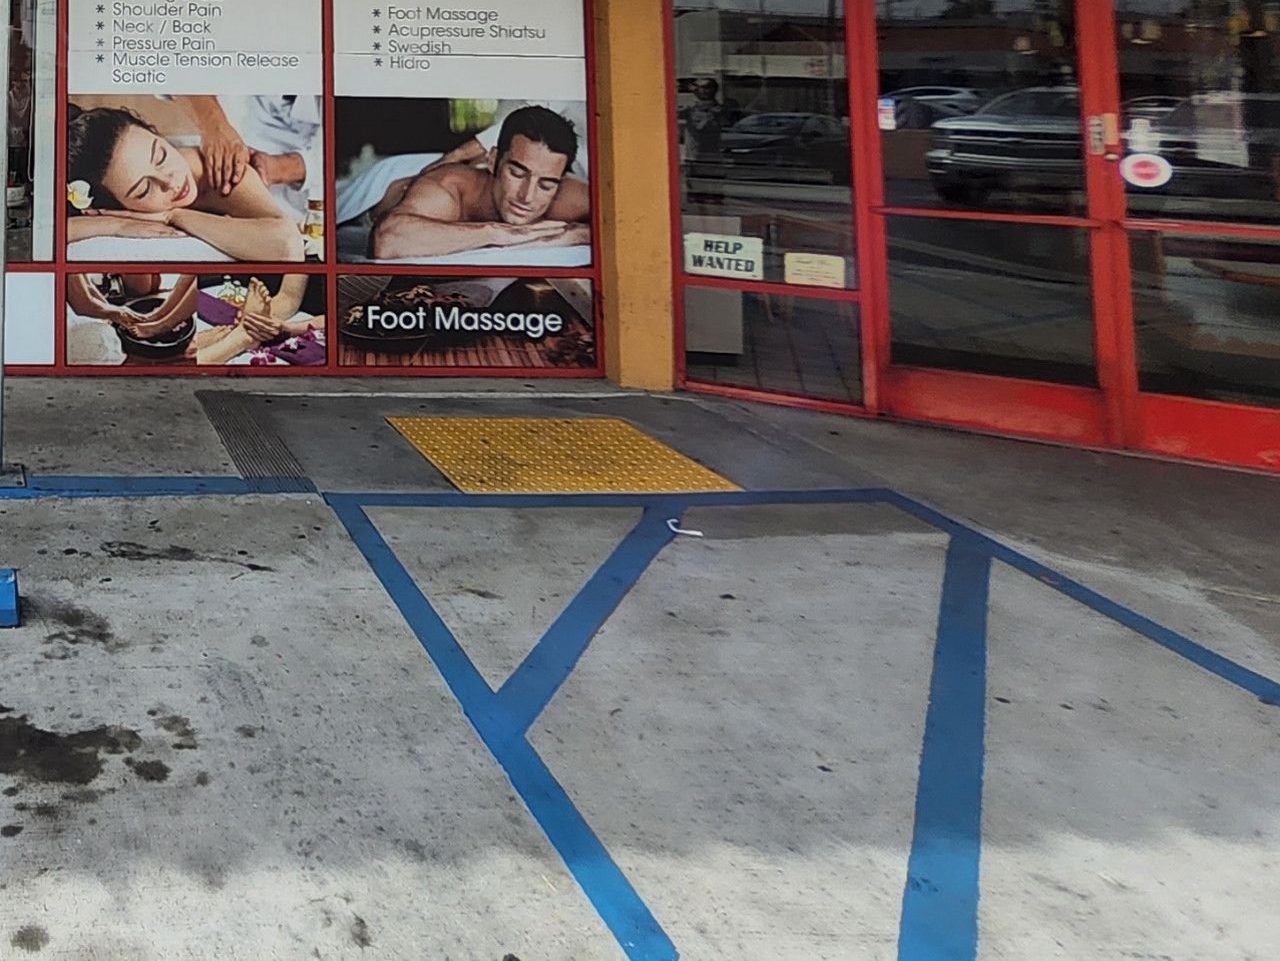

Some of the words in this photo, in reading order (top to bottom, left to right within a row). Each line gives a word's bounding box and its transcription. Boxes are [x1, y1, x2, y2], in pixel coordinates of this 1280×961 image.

[112, 2, 183, 17] Shoulder
[188, 2, 222, 17] Pain
[388, 6, 422, 20] Foot
[426, 7, 499, 24] Massage
[113, 19, 154, 34] Neck
[172, 19, 211, 34] Back
[388, 23, 485, 39] Acupressure
[489, 24, 546, 39] Shiatsu
[113, 36, 177, 51] Pressure
[182, 37, 215, 51] Pain
[388, 40, 451, 54] Swedish
[112, 52, 170, 67] Muscle
[173, 52, 232, 67] Tension
[236, 53, 299, 68] Release
[390, 56, 431, 70] Hidro
[112, 69, 166, 84] Sciatic
[703, 238, 744, 255] HELP
[692, 254, 755, 273] WANTED
[367, 306, 426, 330] Foot
[435, 306, 563, 338] Massage
